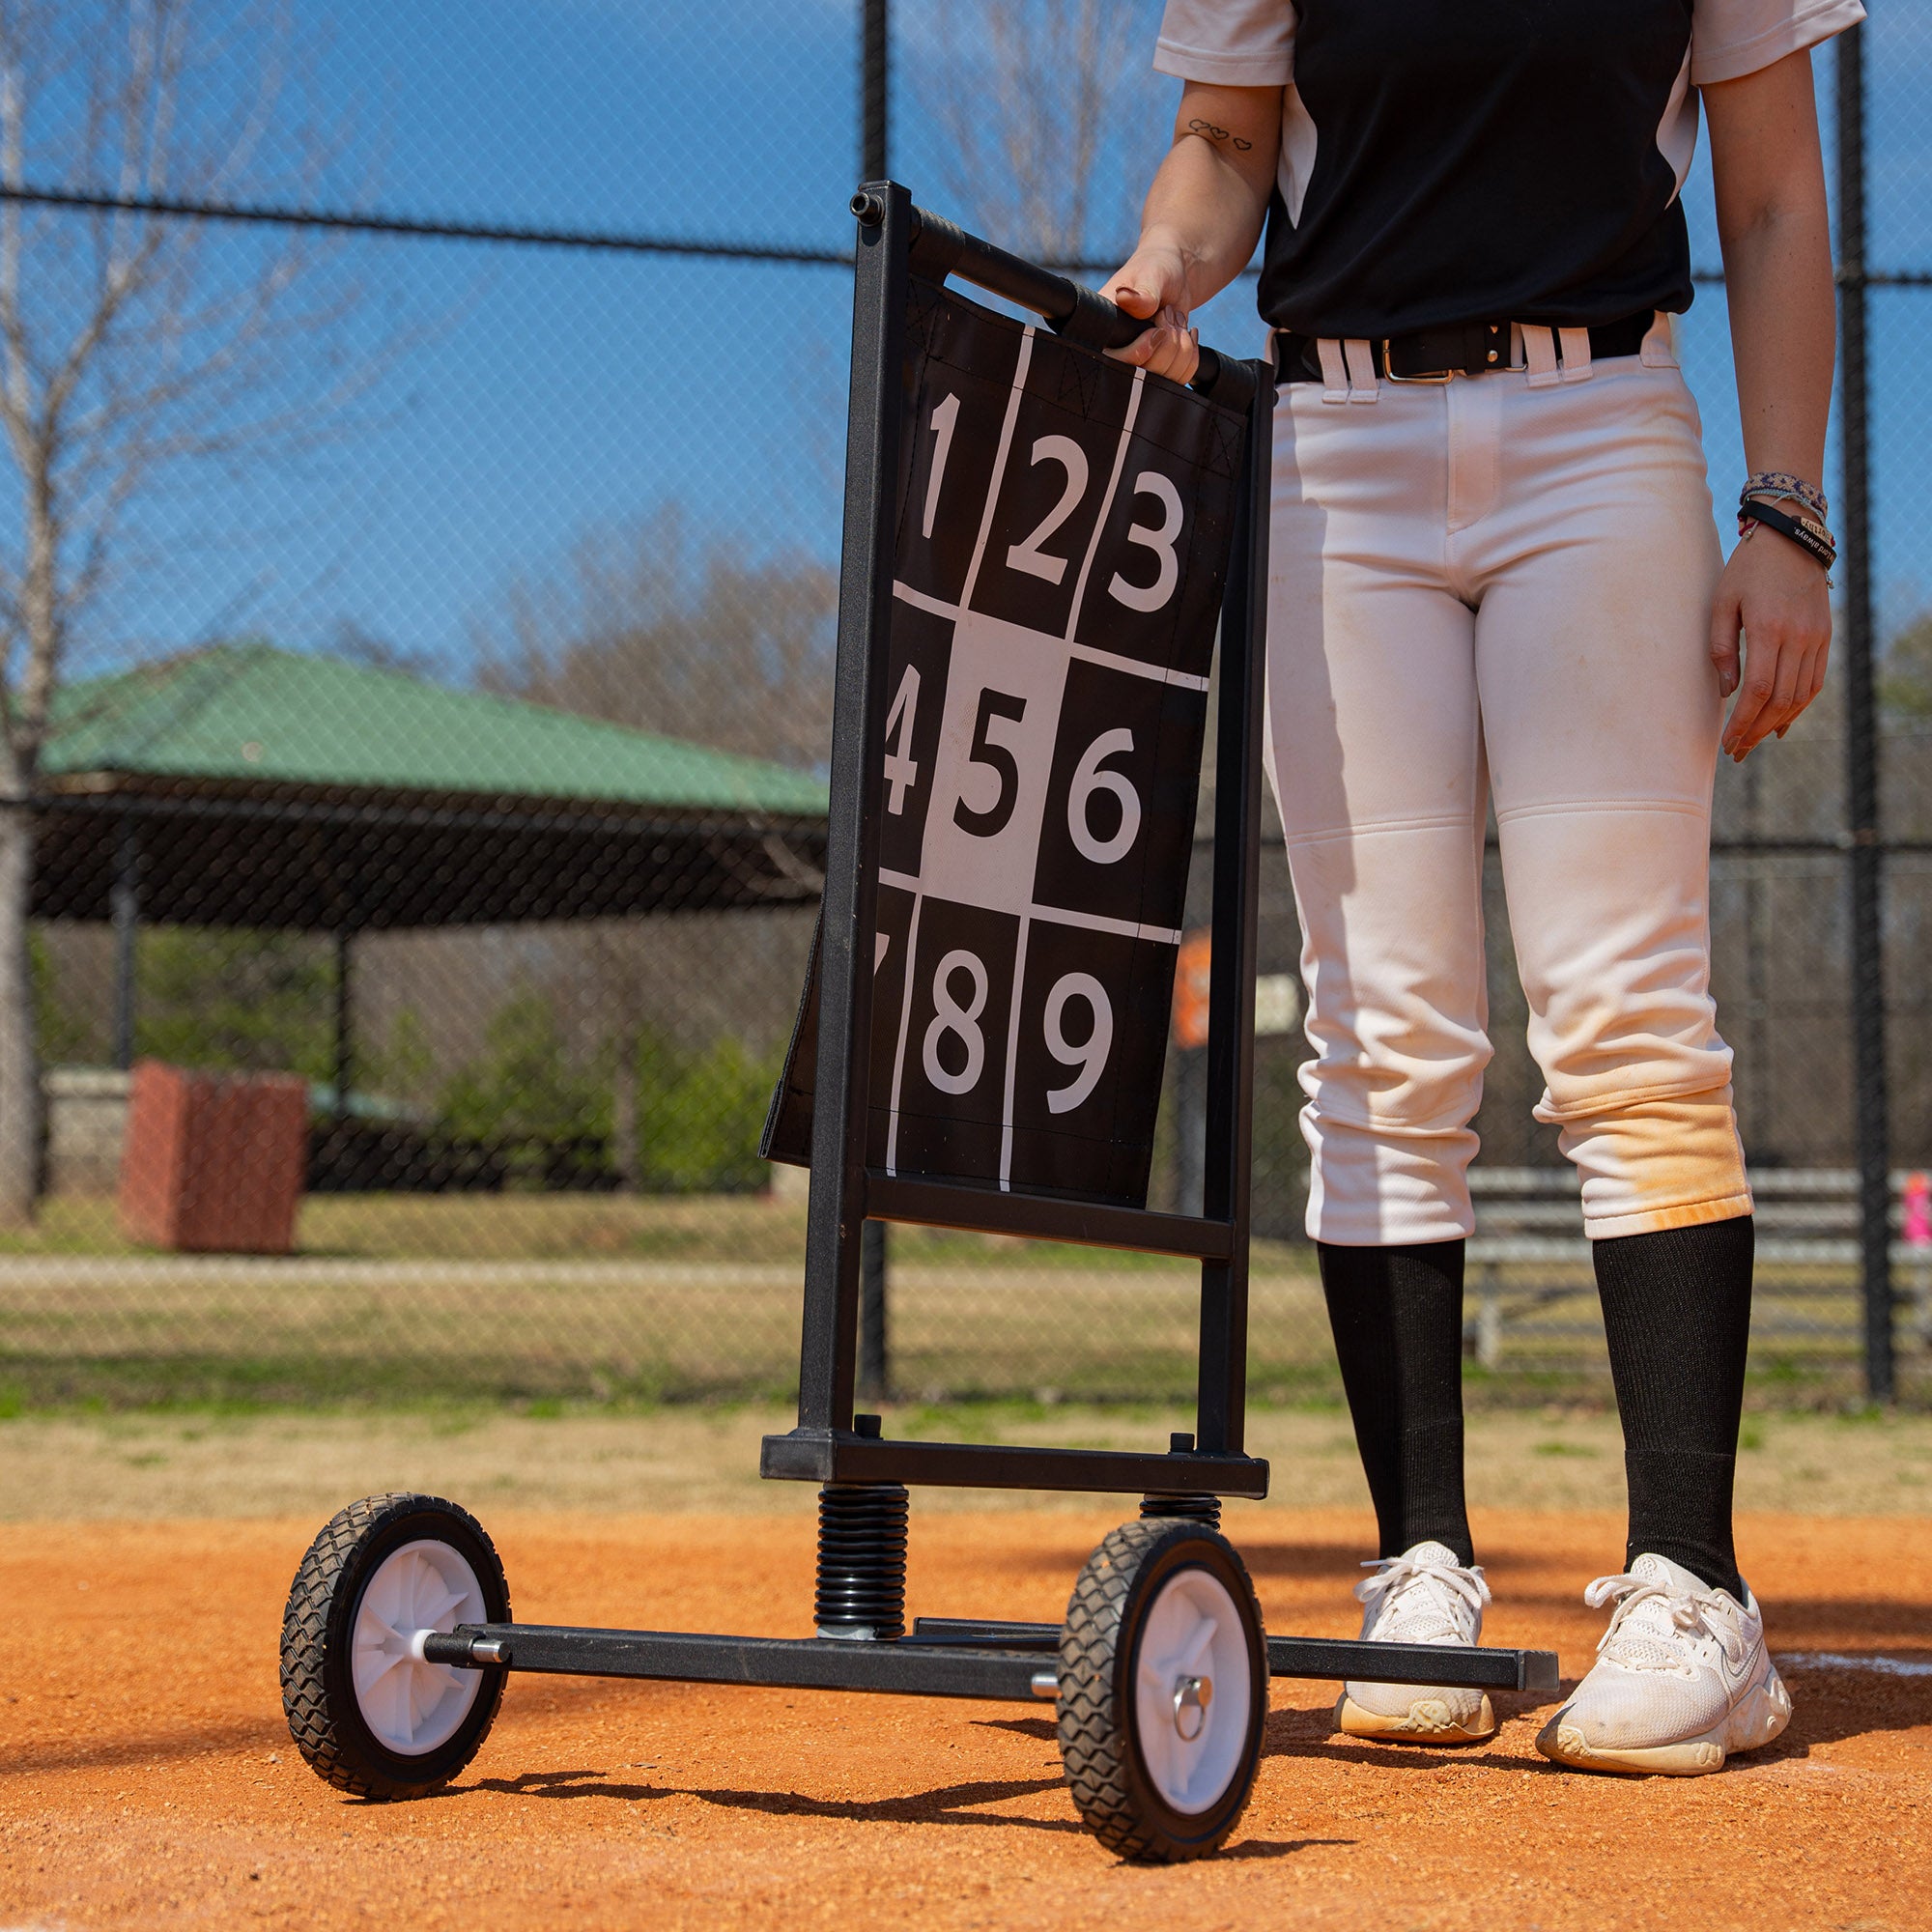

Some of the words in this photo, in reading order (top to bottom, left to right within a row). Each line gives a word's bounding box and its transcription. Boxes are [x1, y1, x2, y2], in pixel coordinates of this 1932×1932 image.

[922, 392, 961, 539] 1
[1006, 435, 1090, 585] 2
[1108, 471, 1184, 612] 3
[883, 663, 921, 815] 4
[952, 687, 1027, 838] 5
[1067, 728, 1142, 864] 6
[923, 950, 988, 1094] 8
[1043, 972, 1113, 1114] 9
